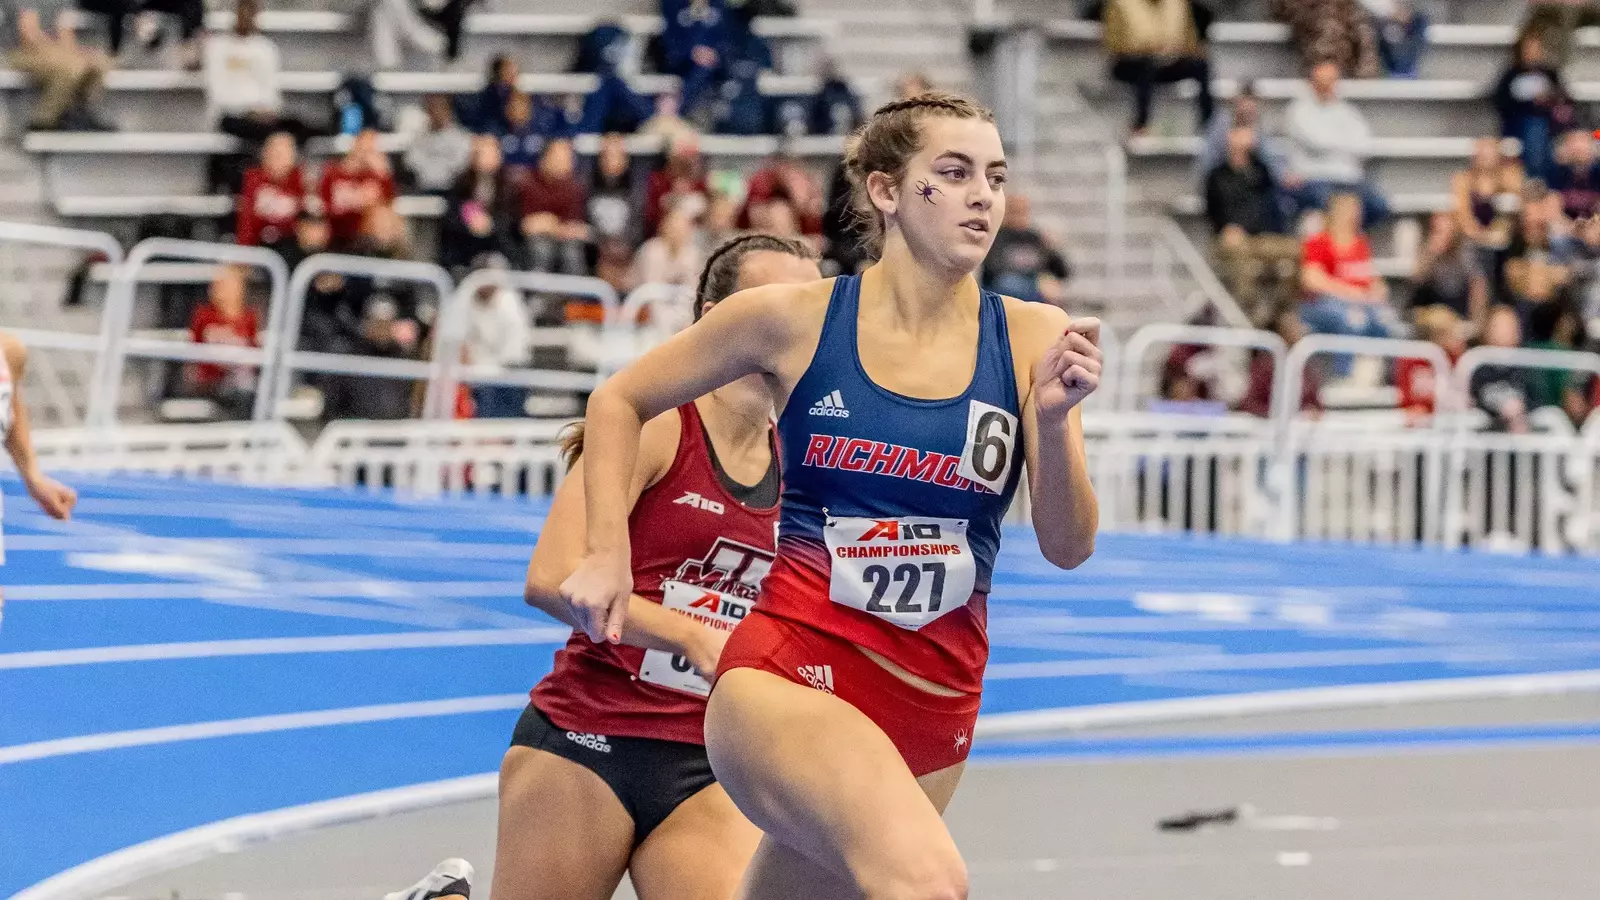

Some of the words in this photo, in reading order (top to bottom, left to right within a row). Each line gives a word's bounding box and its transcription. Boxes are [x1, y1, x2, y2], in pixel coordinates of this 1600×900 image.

[809, 404, 849, 418] adidas
[972, 411, 1010, 482] 6
[802, 433, 1000, 494] RICHMO
[673, 491, 725, 515] A10
[856, 520, 942, 541] A10
[836, 544, 961, 558] CHAMPIONSHIPS
[862, 562, 946, 613] 227
[688, 592, 746, 619] A10
[566, 731, 611, 753] adidas
